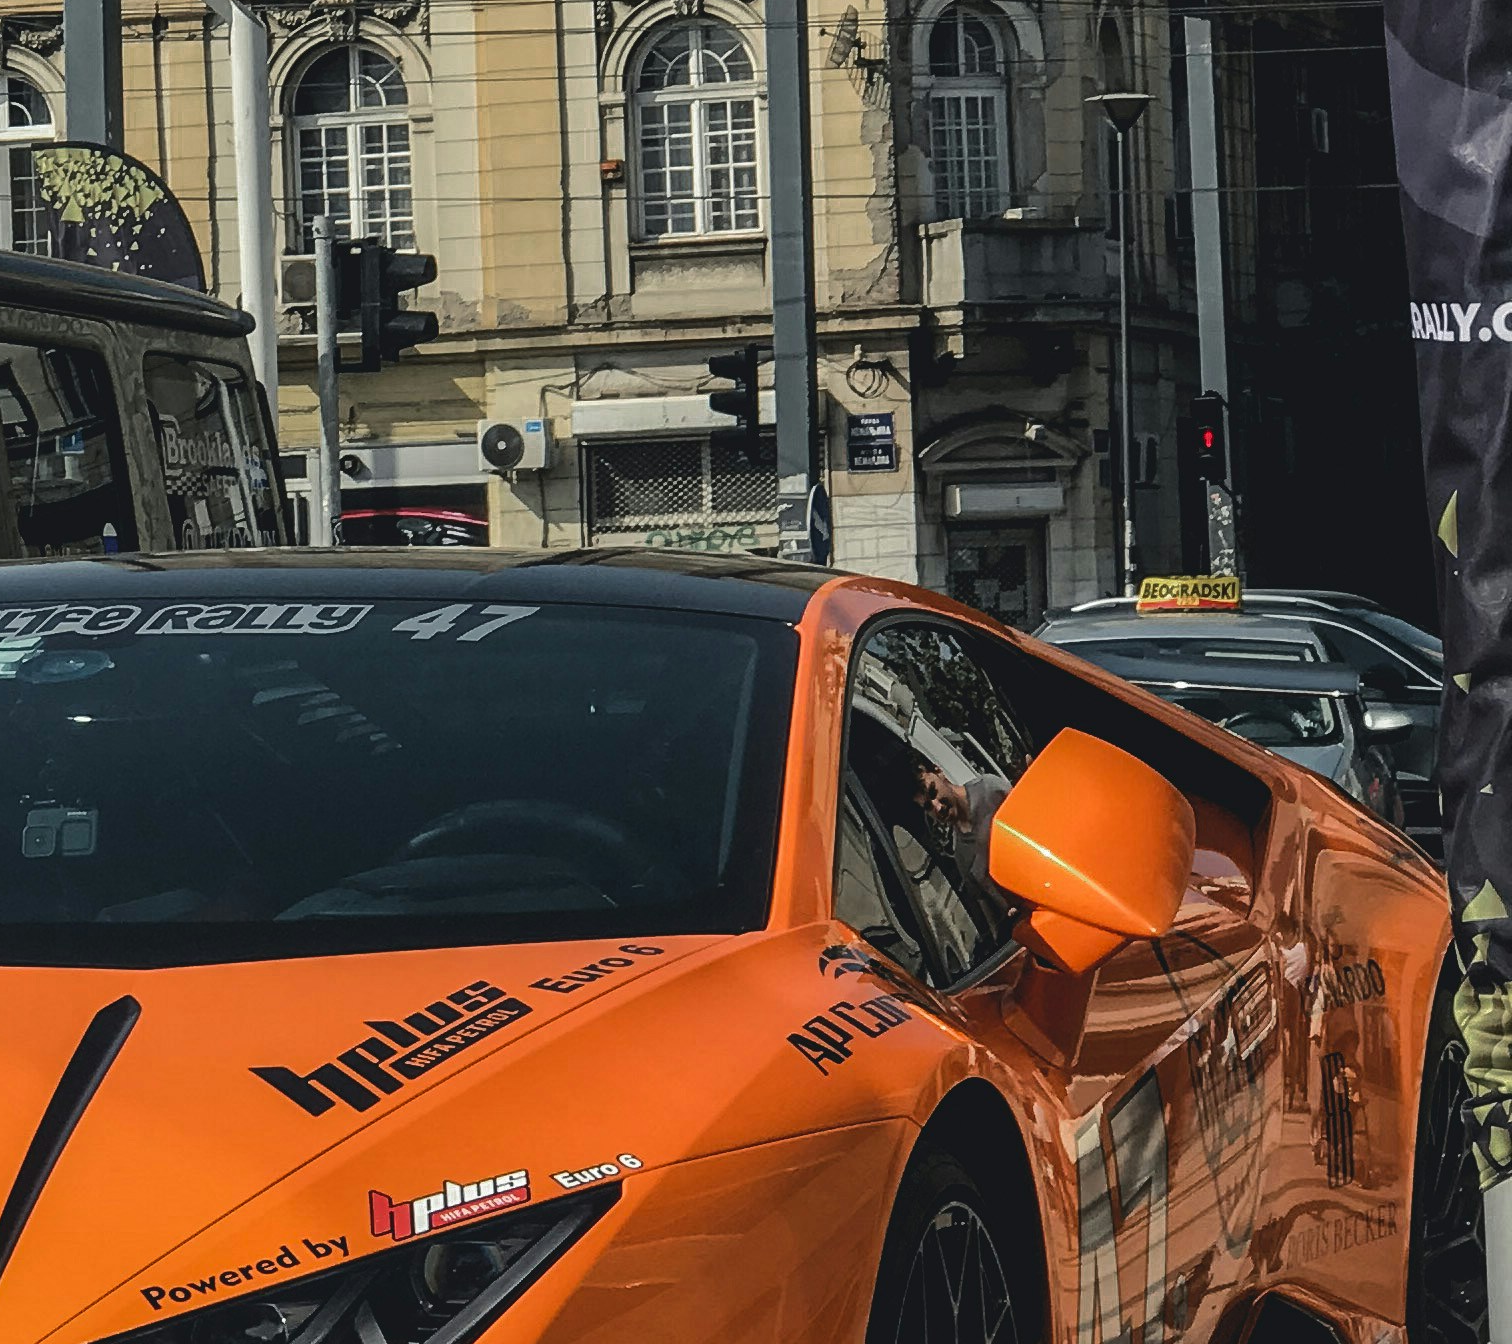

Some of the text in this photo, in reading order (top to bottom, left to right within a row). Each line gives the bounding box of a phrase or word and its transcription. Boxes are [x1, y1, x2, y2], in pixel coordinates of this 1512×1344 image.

[1141, 581, 1236, 600] BEOGRADSKI
[392, 604, 541, 642] 47
[248, 944, 665, 1117] hplus Euro 6
[403, 1007, 520, 1068] HIFA PETROL
[786, 1015, 855, 1076] AP
[140, 1153, 644, 1311] Powered by hplus Euro 6
[438, 1192, 521, 1224] HIFA PETROL
[1333, 1201, 1398, 1254] BECKER
